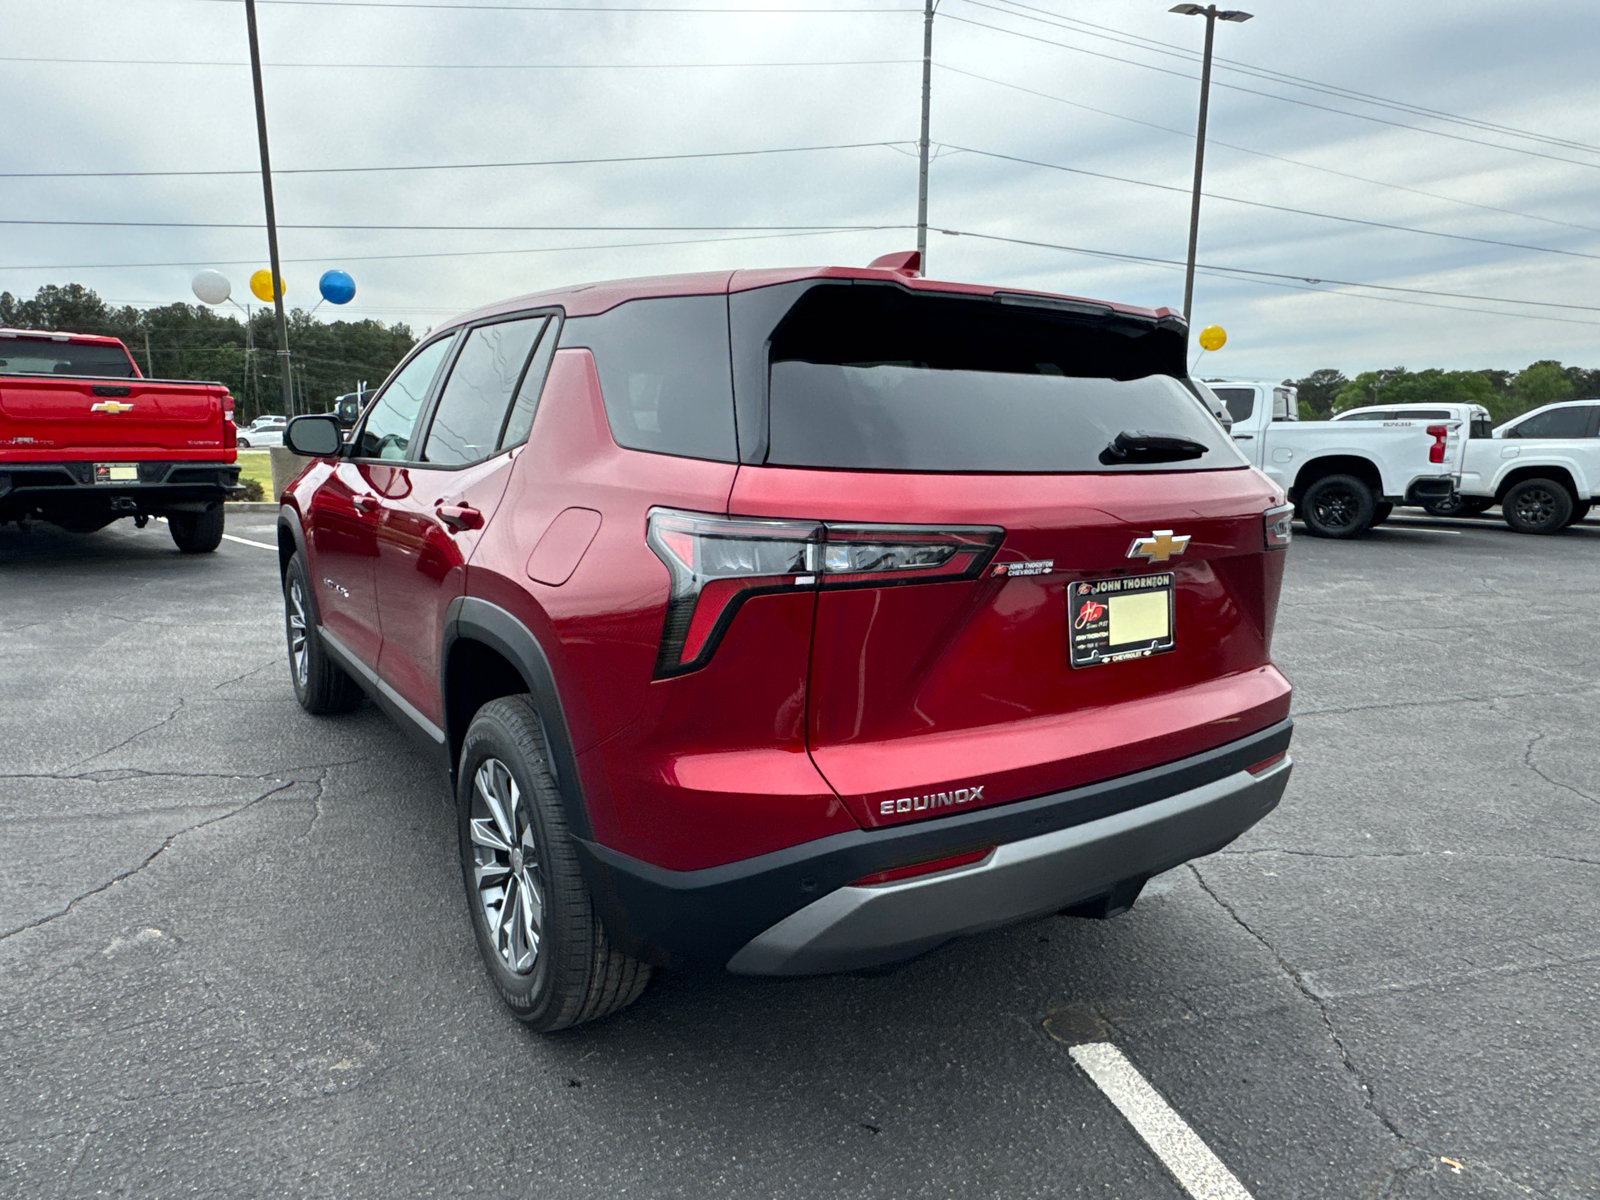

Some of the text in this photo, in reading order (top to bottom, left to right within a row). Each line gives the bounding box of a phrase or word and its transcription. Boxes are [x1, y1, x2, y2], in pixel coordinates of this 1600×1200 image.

[1025, 561, 1054, 569] THORNTON
[1008, 568, 1042, 577] CHEVROLET
[1095, 575, 1170, 592] JOHN THORNTON
[1112, 651, 1142, 662] CHEVROLET
[880, 785, 984, 815] EQUINOX
